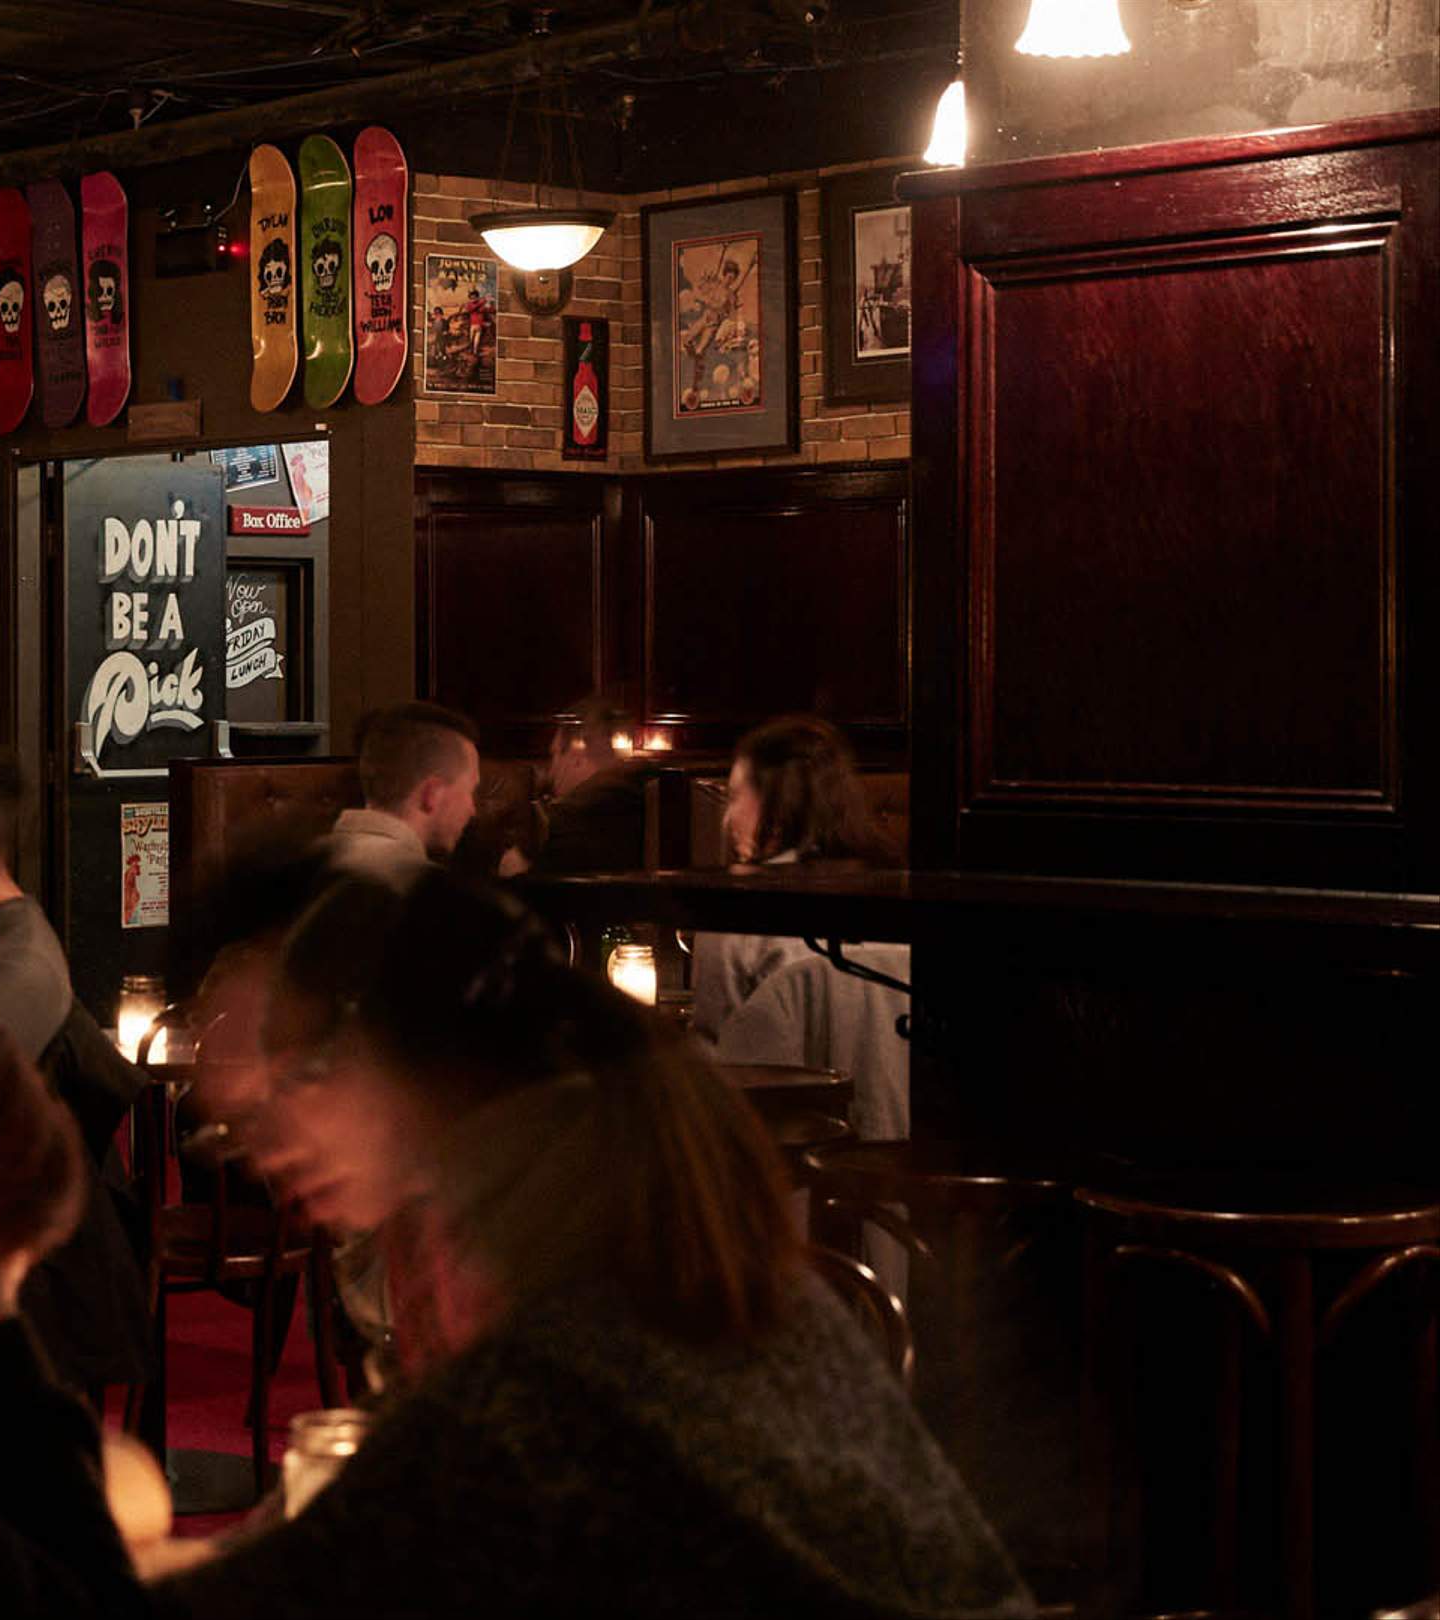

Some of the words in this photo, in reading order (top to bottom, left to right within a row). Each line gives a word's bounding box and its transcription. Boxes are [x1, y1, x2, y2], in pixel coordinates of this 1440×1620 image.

[242, 512, 265, 528] Box
[266, 512, 301, 529] Office
[104, 500, 201, 579] DON'T
[112, 592, 149, 641] BE
[159, 593, 185, 641] A
[226, 622, 266, 652] FRIDAY
[231, 653, 268, 681] LUNCH
